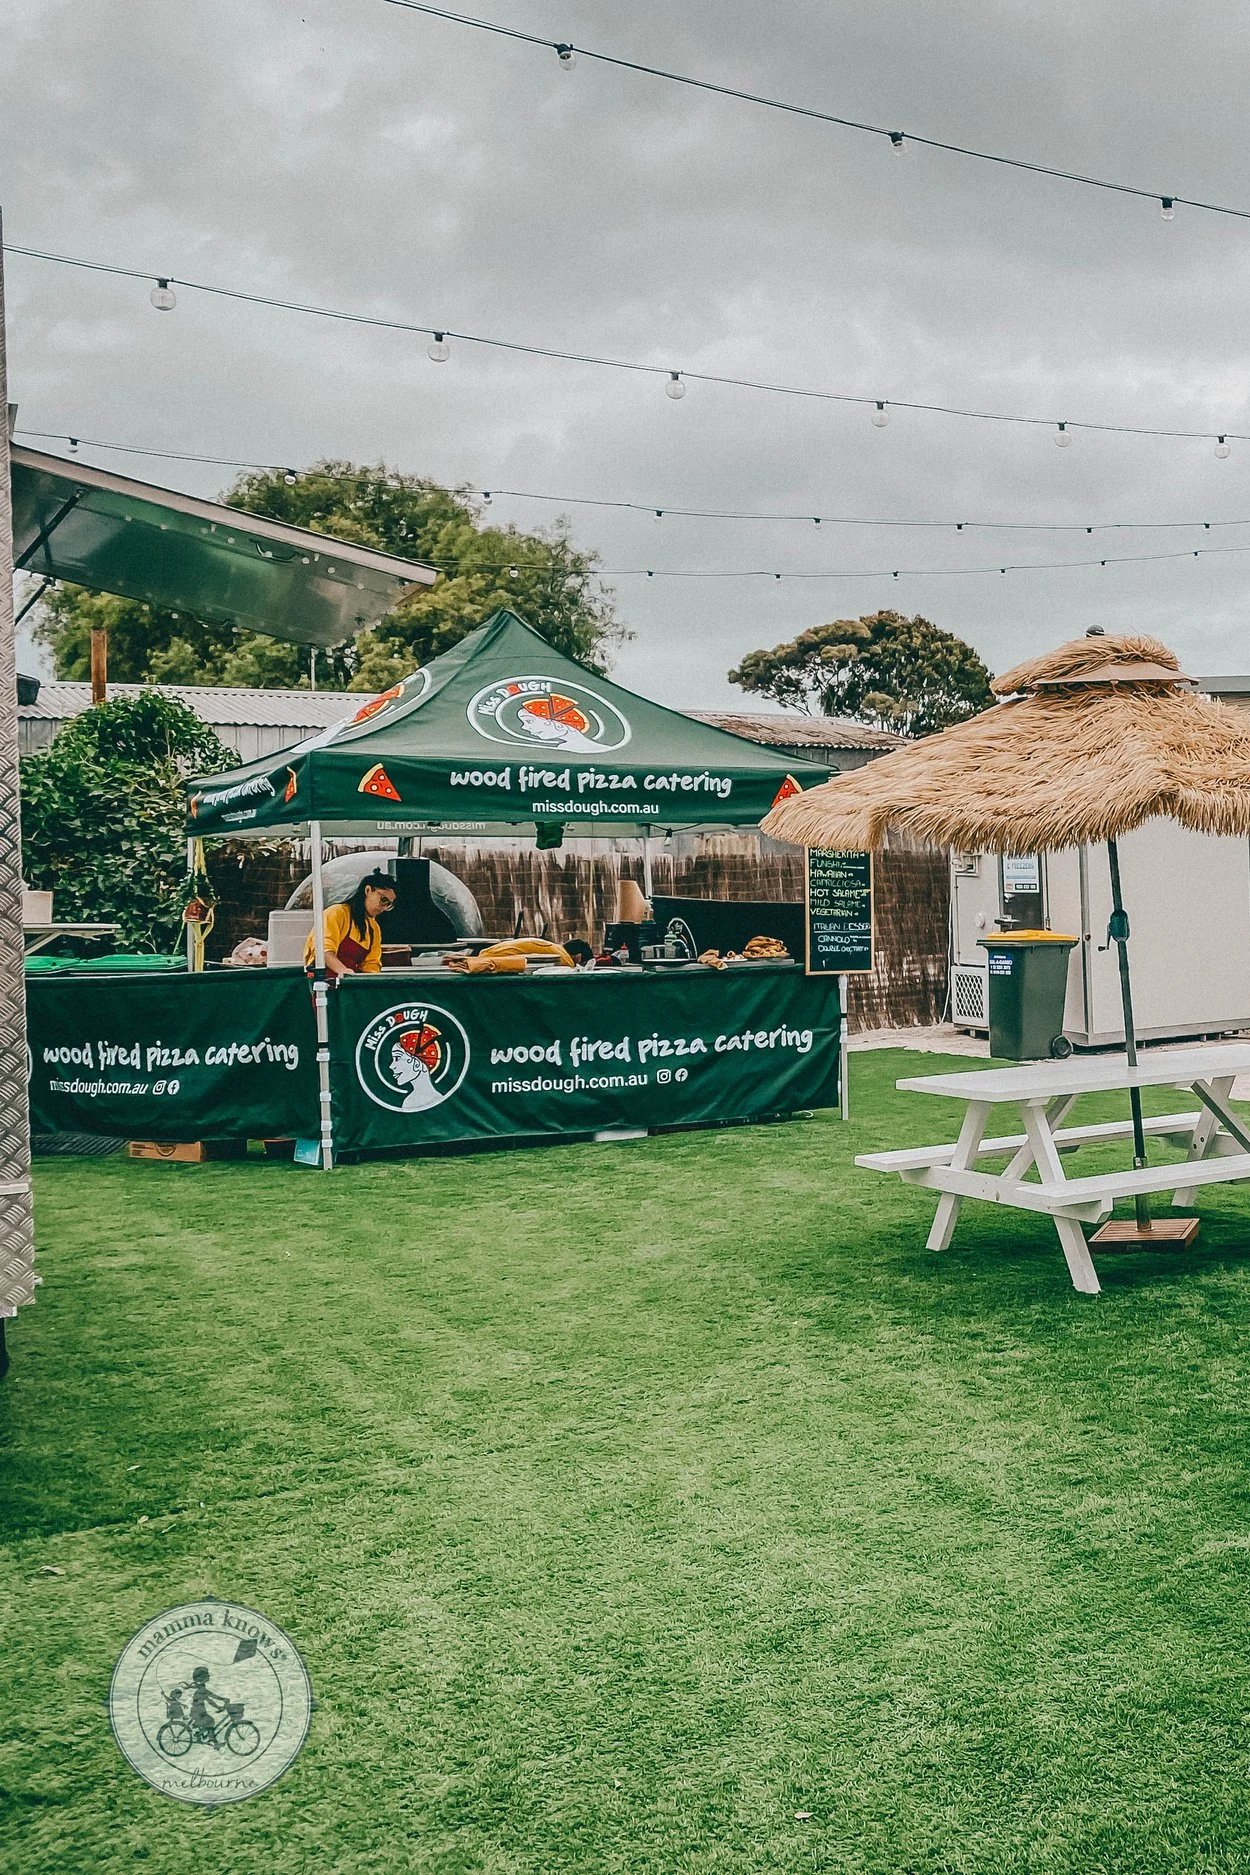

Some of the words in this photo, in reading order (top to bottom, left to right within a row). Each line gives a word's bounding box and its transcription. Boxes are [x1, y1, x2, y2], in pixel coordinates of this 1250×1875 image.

[450, 767, 510, 790] wood
[518, 766, 570, 792] fired
[577, 768, 637, 793] pizza
[643, 771, 733, 798] catering
[532, 800, 660, 816] missdough.com.au
[810, 888, 829, 897] HOT
[43, 1043, 93, 1068] wood
[98, 1040, 141, 1071] fired
[146, 1040, 200, 1071] pizza
[204, 1037, 299, 1070] catering
[490, 1040, 562, 1065] wood
[570, 1036, 631, 1067] fired
[638, 1033, 707, 1063] pizza
[714, 1024, 813, 1053] catering
[50, 1077, 149, 1097] missdough.com.au
[491, 1073, 648, 1093] missdough.com.au
